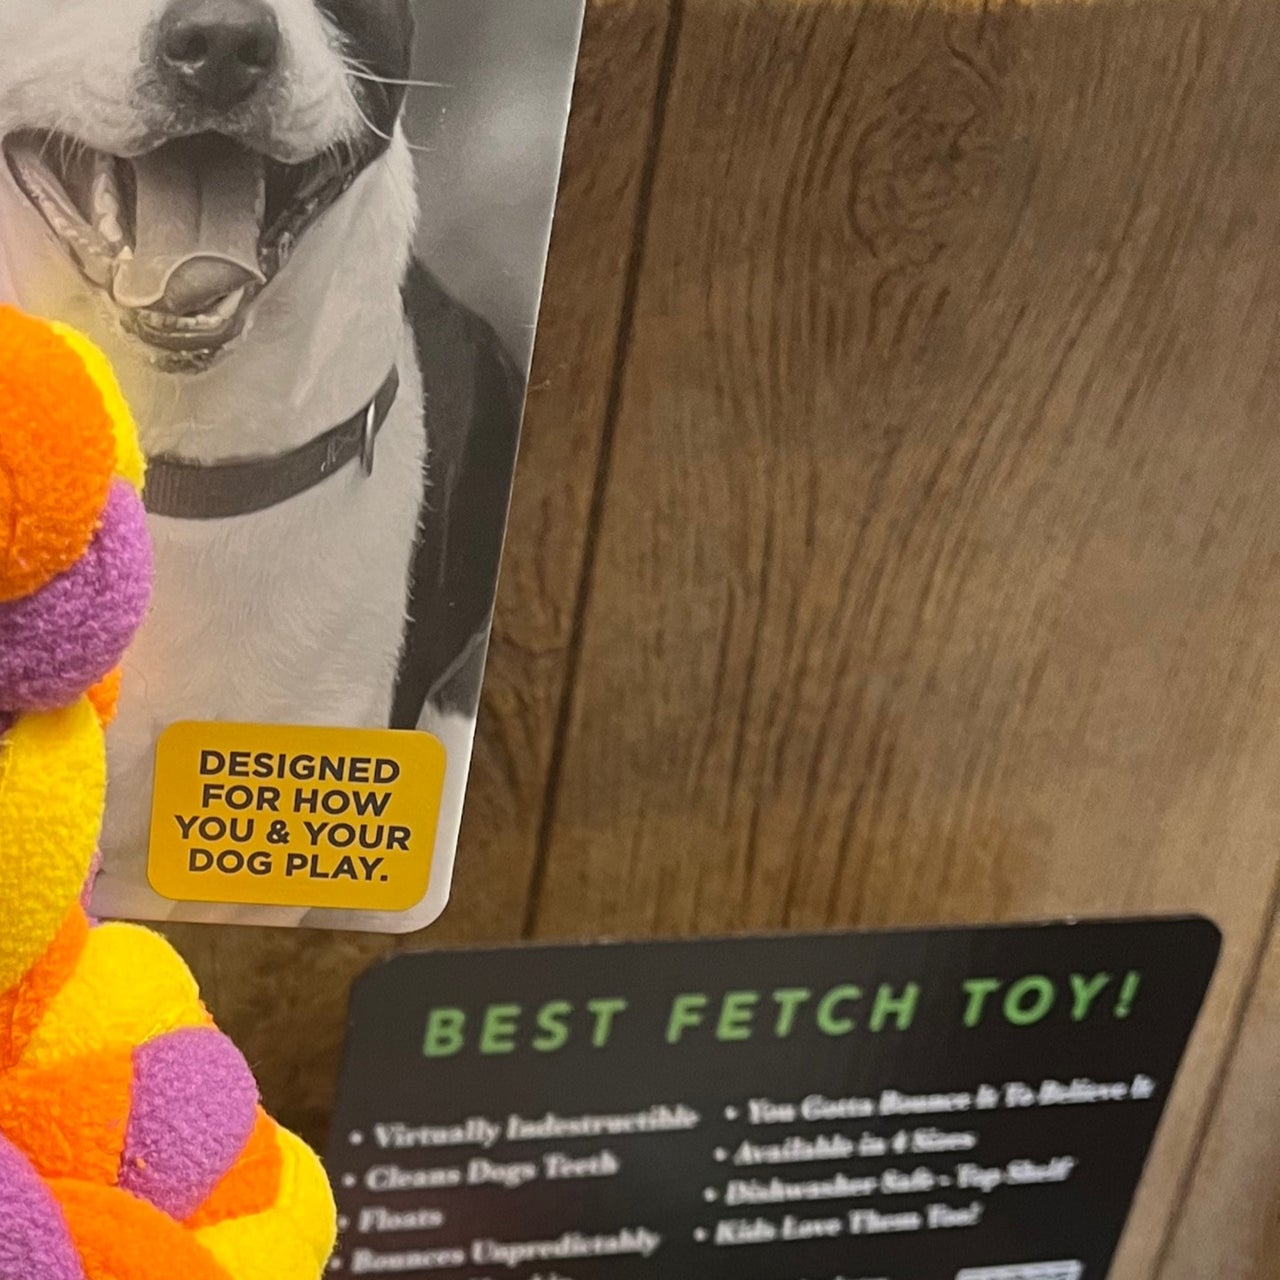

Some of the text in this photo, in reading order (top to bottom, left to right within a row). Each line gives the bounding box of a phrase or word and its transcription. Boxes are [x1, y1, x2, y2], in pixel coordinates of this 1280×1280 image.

[199, 750, 401, 785] DESIGNED
[201, 784, 392, 817] FOR HOW
[173, 814, 411, 851] YOU & YOUR
[188, 848, 389, 882] DOG PLAY.
[422, 971, 1141, 1057] BEST FETCH TOY!
[373, 1103, 701, 1149] Virtually Indestructible
[747, 1097, 796, 1125] You
[800, 1093, 875, 1122] Gotta
[733, 1134, 854, 1167] Available
[365, 1149, 620, 1192] Cleans Dogs Teeth
[725, 1172, 879, 1206] Dishwasher
[357, 1206, 445, 1233] Floats
[715, 1216, 778, 1246] Kids
[781, 1214, 843, 1241] Love
[848, 1208, 922, 1236] Them
[350, 1225, 662, 1275] Bounces Unpredictably
